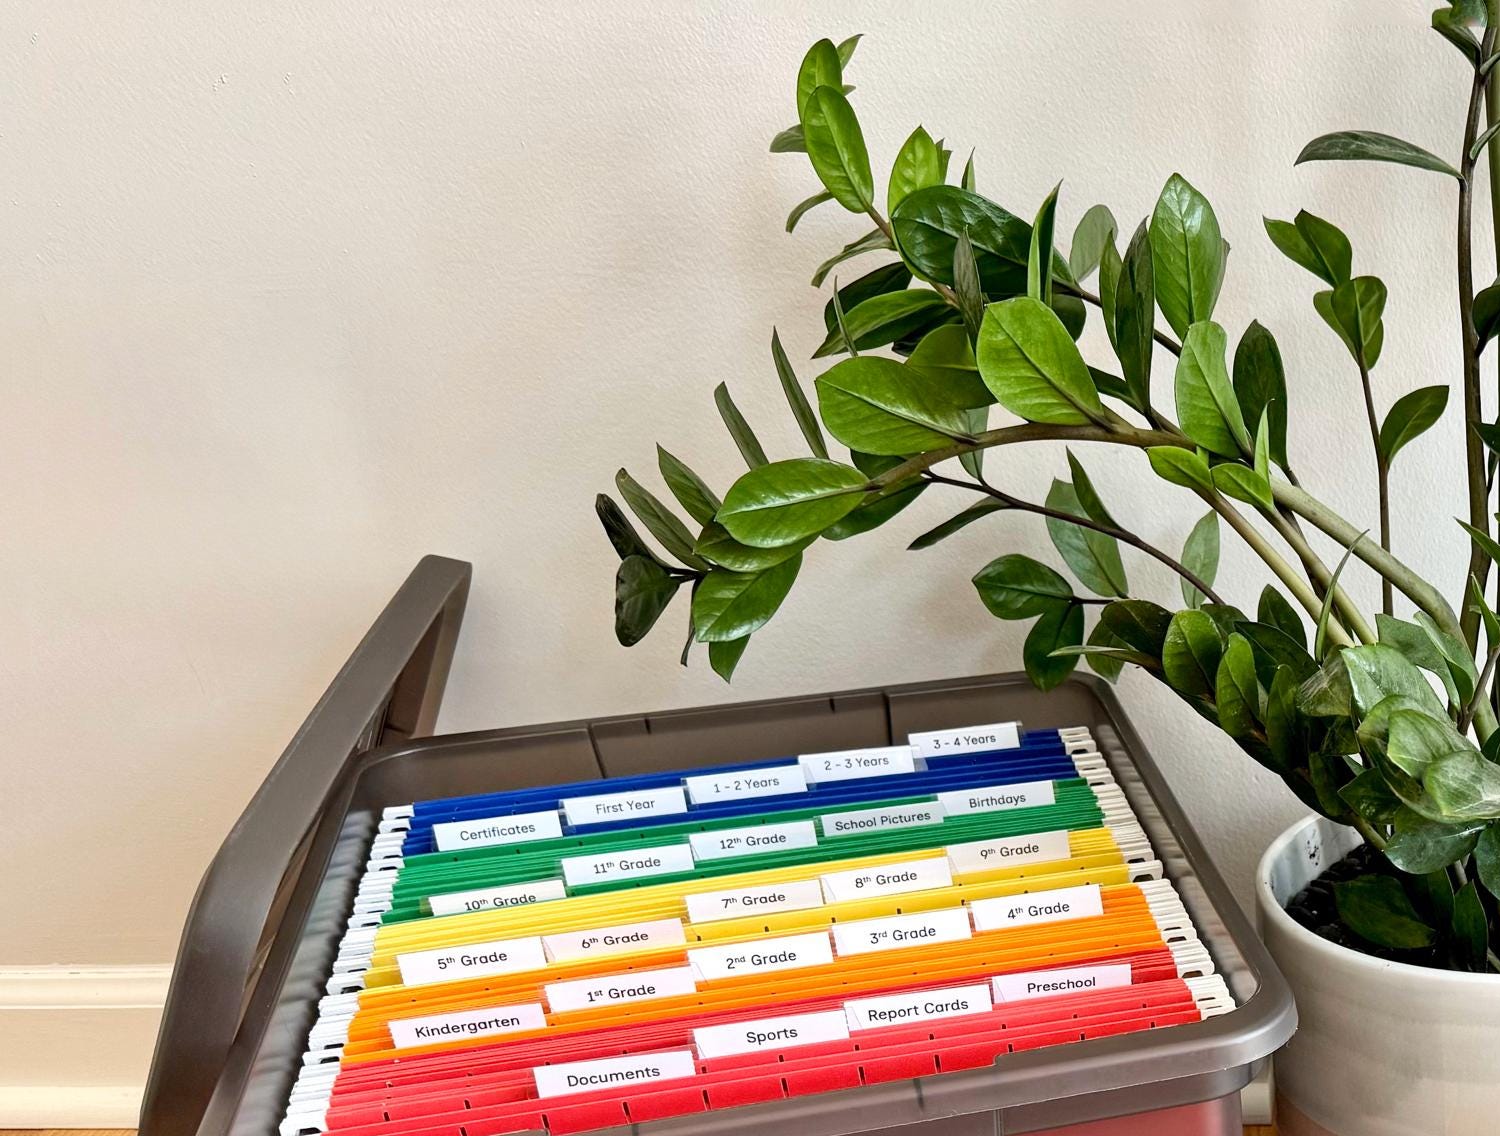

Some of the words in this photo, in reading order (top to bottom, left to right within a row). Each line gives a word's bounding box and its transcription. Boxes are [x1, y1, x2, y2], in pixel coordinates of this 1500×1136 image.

[933, 739, 941, 750] 3
[953, 737, 961, 746] 4
[963, 735, 997, 746] Years
[824, 760, 832, 771] 2
[844, 758, 853, 769] 3
[855, 757, 890, 768] Years
[714, 783, 721, 793] 1
[733, 780, 742, 791] 2
[744, 778, 780, 790] Years
[595, 802, 623, 815] First
[626, 800, 655, 811] Year
[968, 794, 1027, 809] Birthdays
[835, 817, 877, 831] School
[880, 812, 931, 825] Pictures
[460, 824, 536, 841] Certificates
[720, 837, 742, 850] 12th
[745, 833, 787, 847] Grade
[980, 848, 996, 860] 9th
[999, 843, 1040, 857] Grade
[593, 861, 615, 875] 11th
[619, 857, 661, 871] Grade
[855, 876, 871, 889] 8th
[875, 871, 918, 886] Grade
[464, 900, 488, 911] 10th
[493, 894, 537, 907] Grade
[721, 897, 738, 909] 7th
[742, 893, 786, 906] Grade
[1007, 907, 1023, 920] 4th
[1028, 902, 1070, 917] Grade
[581, 937, 599, 949] 6th
[603, 932, 649, 946] Grade
[869, 930, 888, 945] 3rd
[892, 926, 936, 941] Grade
[437, 957, 456, 970] 5th
[460, 951, 508, 967] Grade
[726, 955, 746, 970] 2nd
[750, 950, 797, 966] Grade
[587, 989, 603, 1003] 1st
[608, 984, 656, 999] Grade
[1027, 976, 1096, 994] Preschool
[868, 1005, 920, 1025] Report
[924, 999, 969, 1014] Cards
[415, 1013, 520, 1038] Kindergarten
[746, 1028, 798, 1046] Sports
[566, 1065, 661, 1087] Documents
